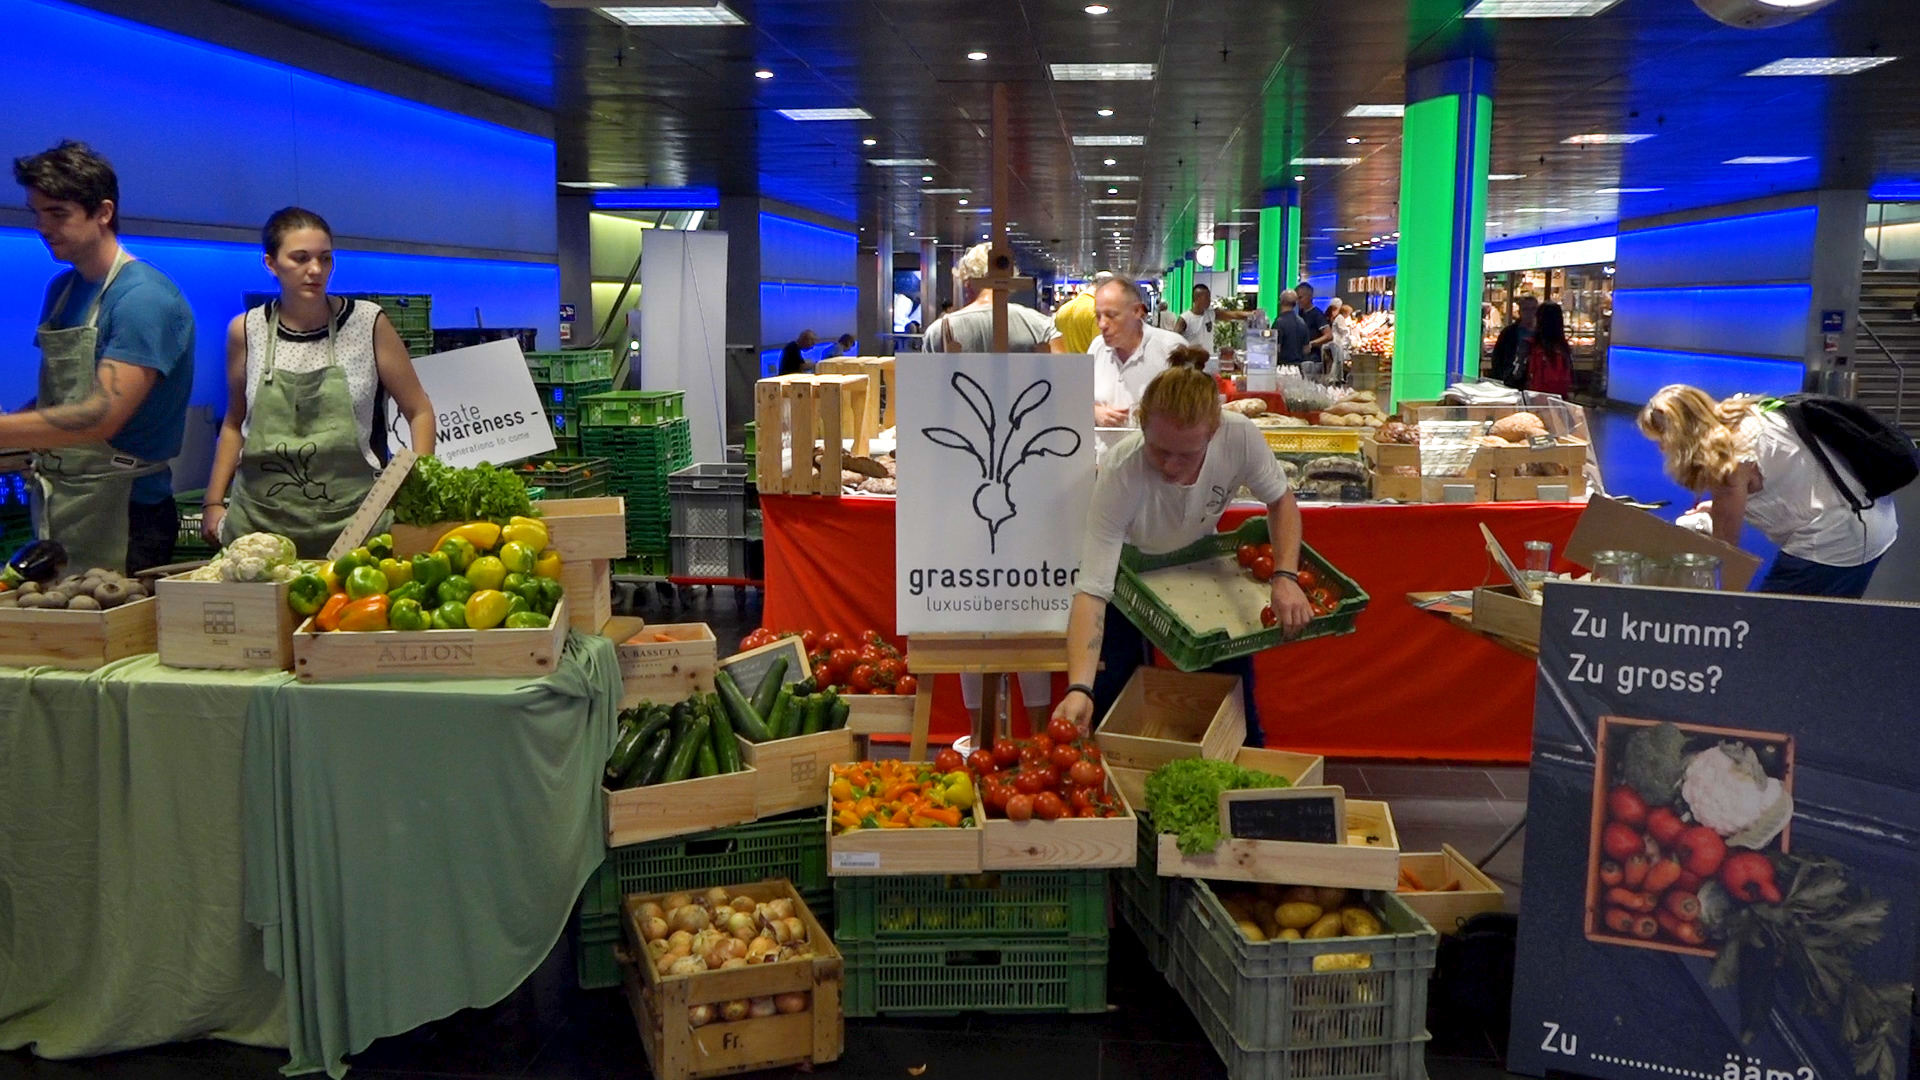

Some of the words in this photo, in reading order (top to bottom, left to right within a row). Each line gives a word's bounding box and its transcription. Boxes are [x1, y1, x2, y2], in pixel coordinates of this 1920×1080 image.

[436, 411, 525, 444] wareness
[438, 404, 481, 427] eate
[446, 440, 495, 461] generations
[508, 432, 530, 442] come
[926, 596, 1069, 612] luxusüberschuss
[1571, 608, 1607, 638] Zu
[1621, 612, 1750, 649] krumm?
[378, 645, 474, 661] ALION
[1568, 653, 1604, 684] Zu
[1617, 665, 1723, 695] gross?
[723, 1032, 744, 1050] Fr.
[1540, 1021, 1578, 1056] Zu
